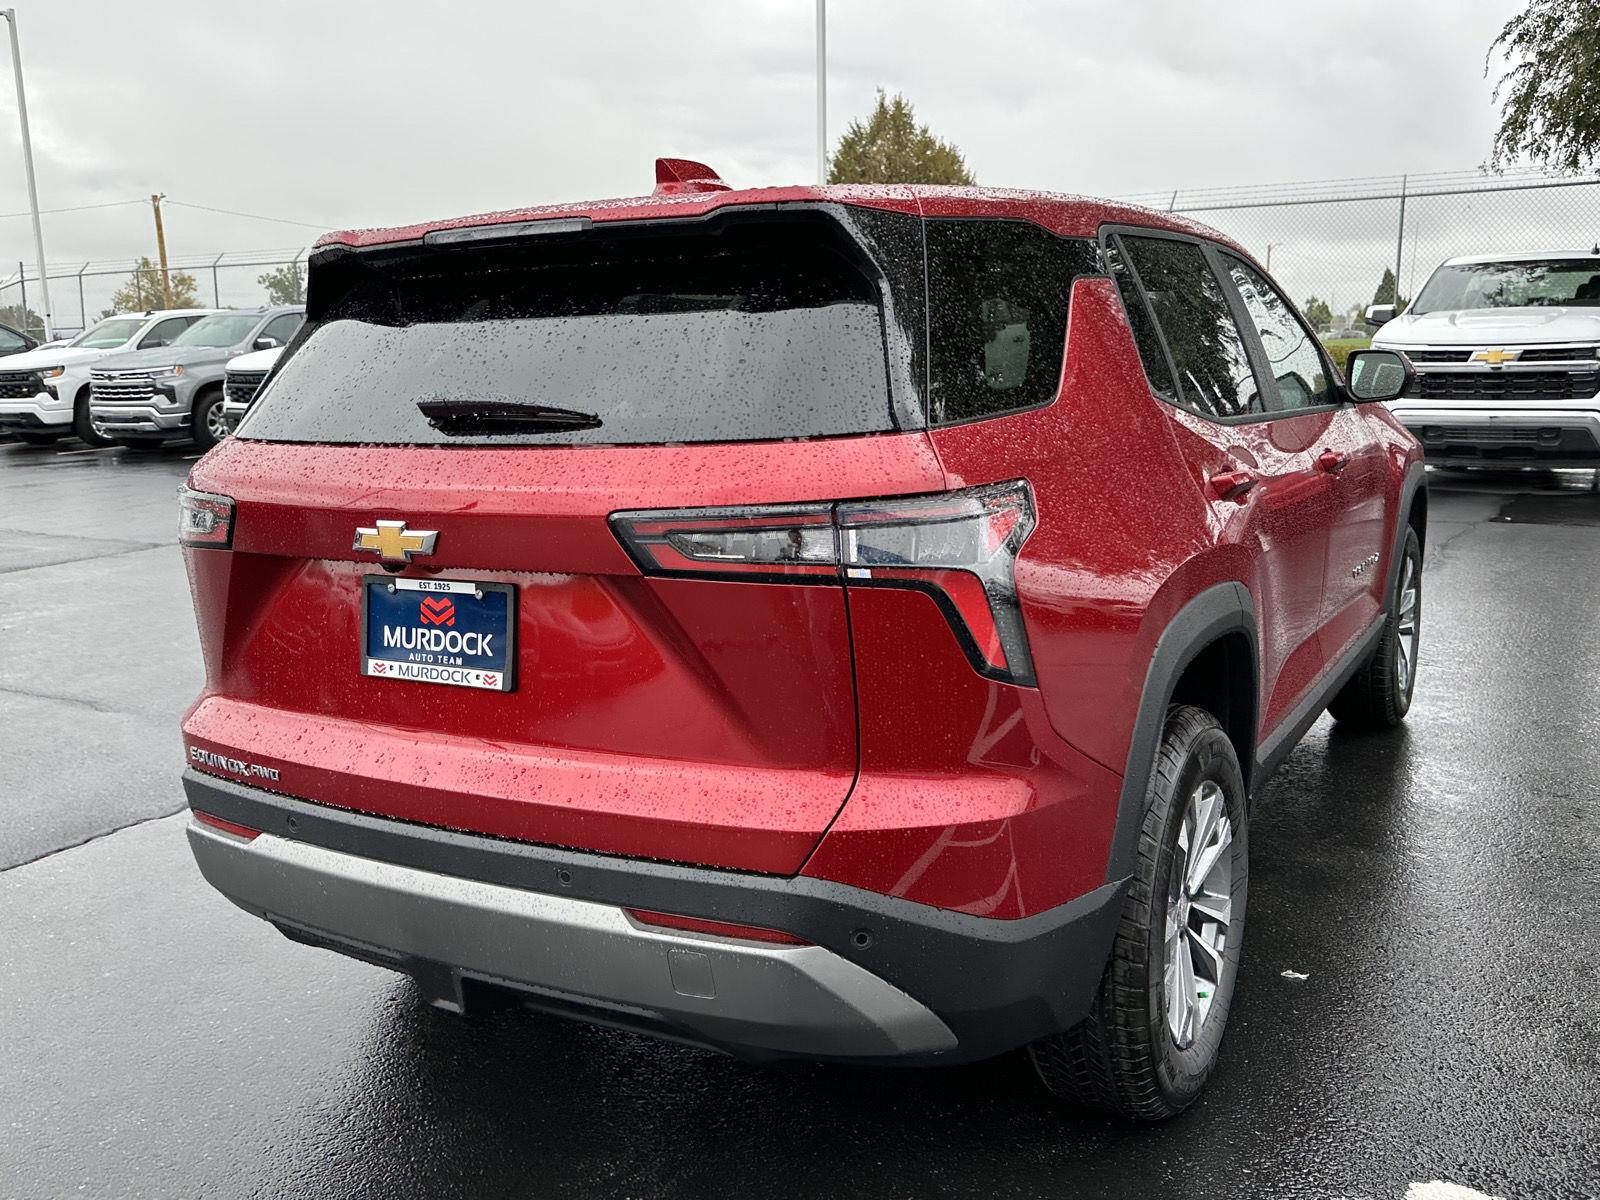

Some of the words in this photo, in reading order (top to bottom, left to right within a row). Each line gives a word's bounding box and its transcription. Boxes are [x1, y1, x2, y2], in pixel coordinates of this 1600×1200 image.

[434, 582, 451, 591] 1925
[383, 625, 493, 657] MURDOCK
[408, 652, 433, 663] AUTO
[437, 655, 463, 666] TEAM
[398, 664, 471, 684] MURDOCK
[190, 746, 249, 776] EQUINOX
[250, 764, 280, 781] AWD
